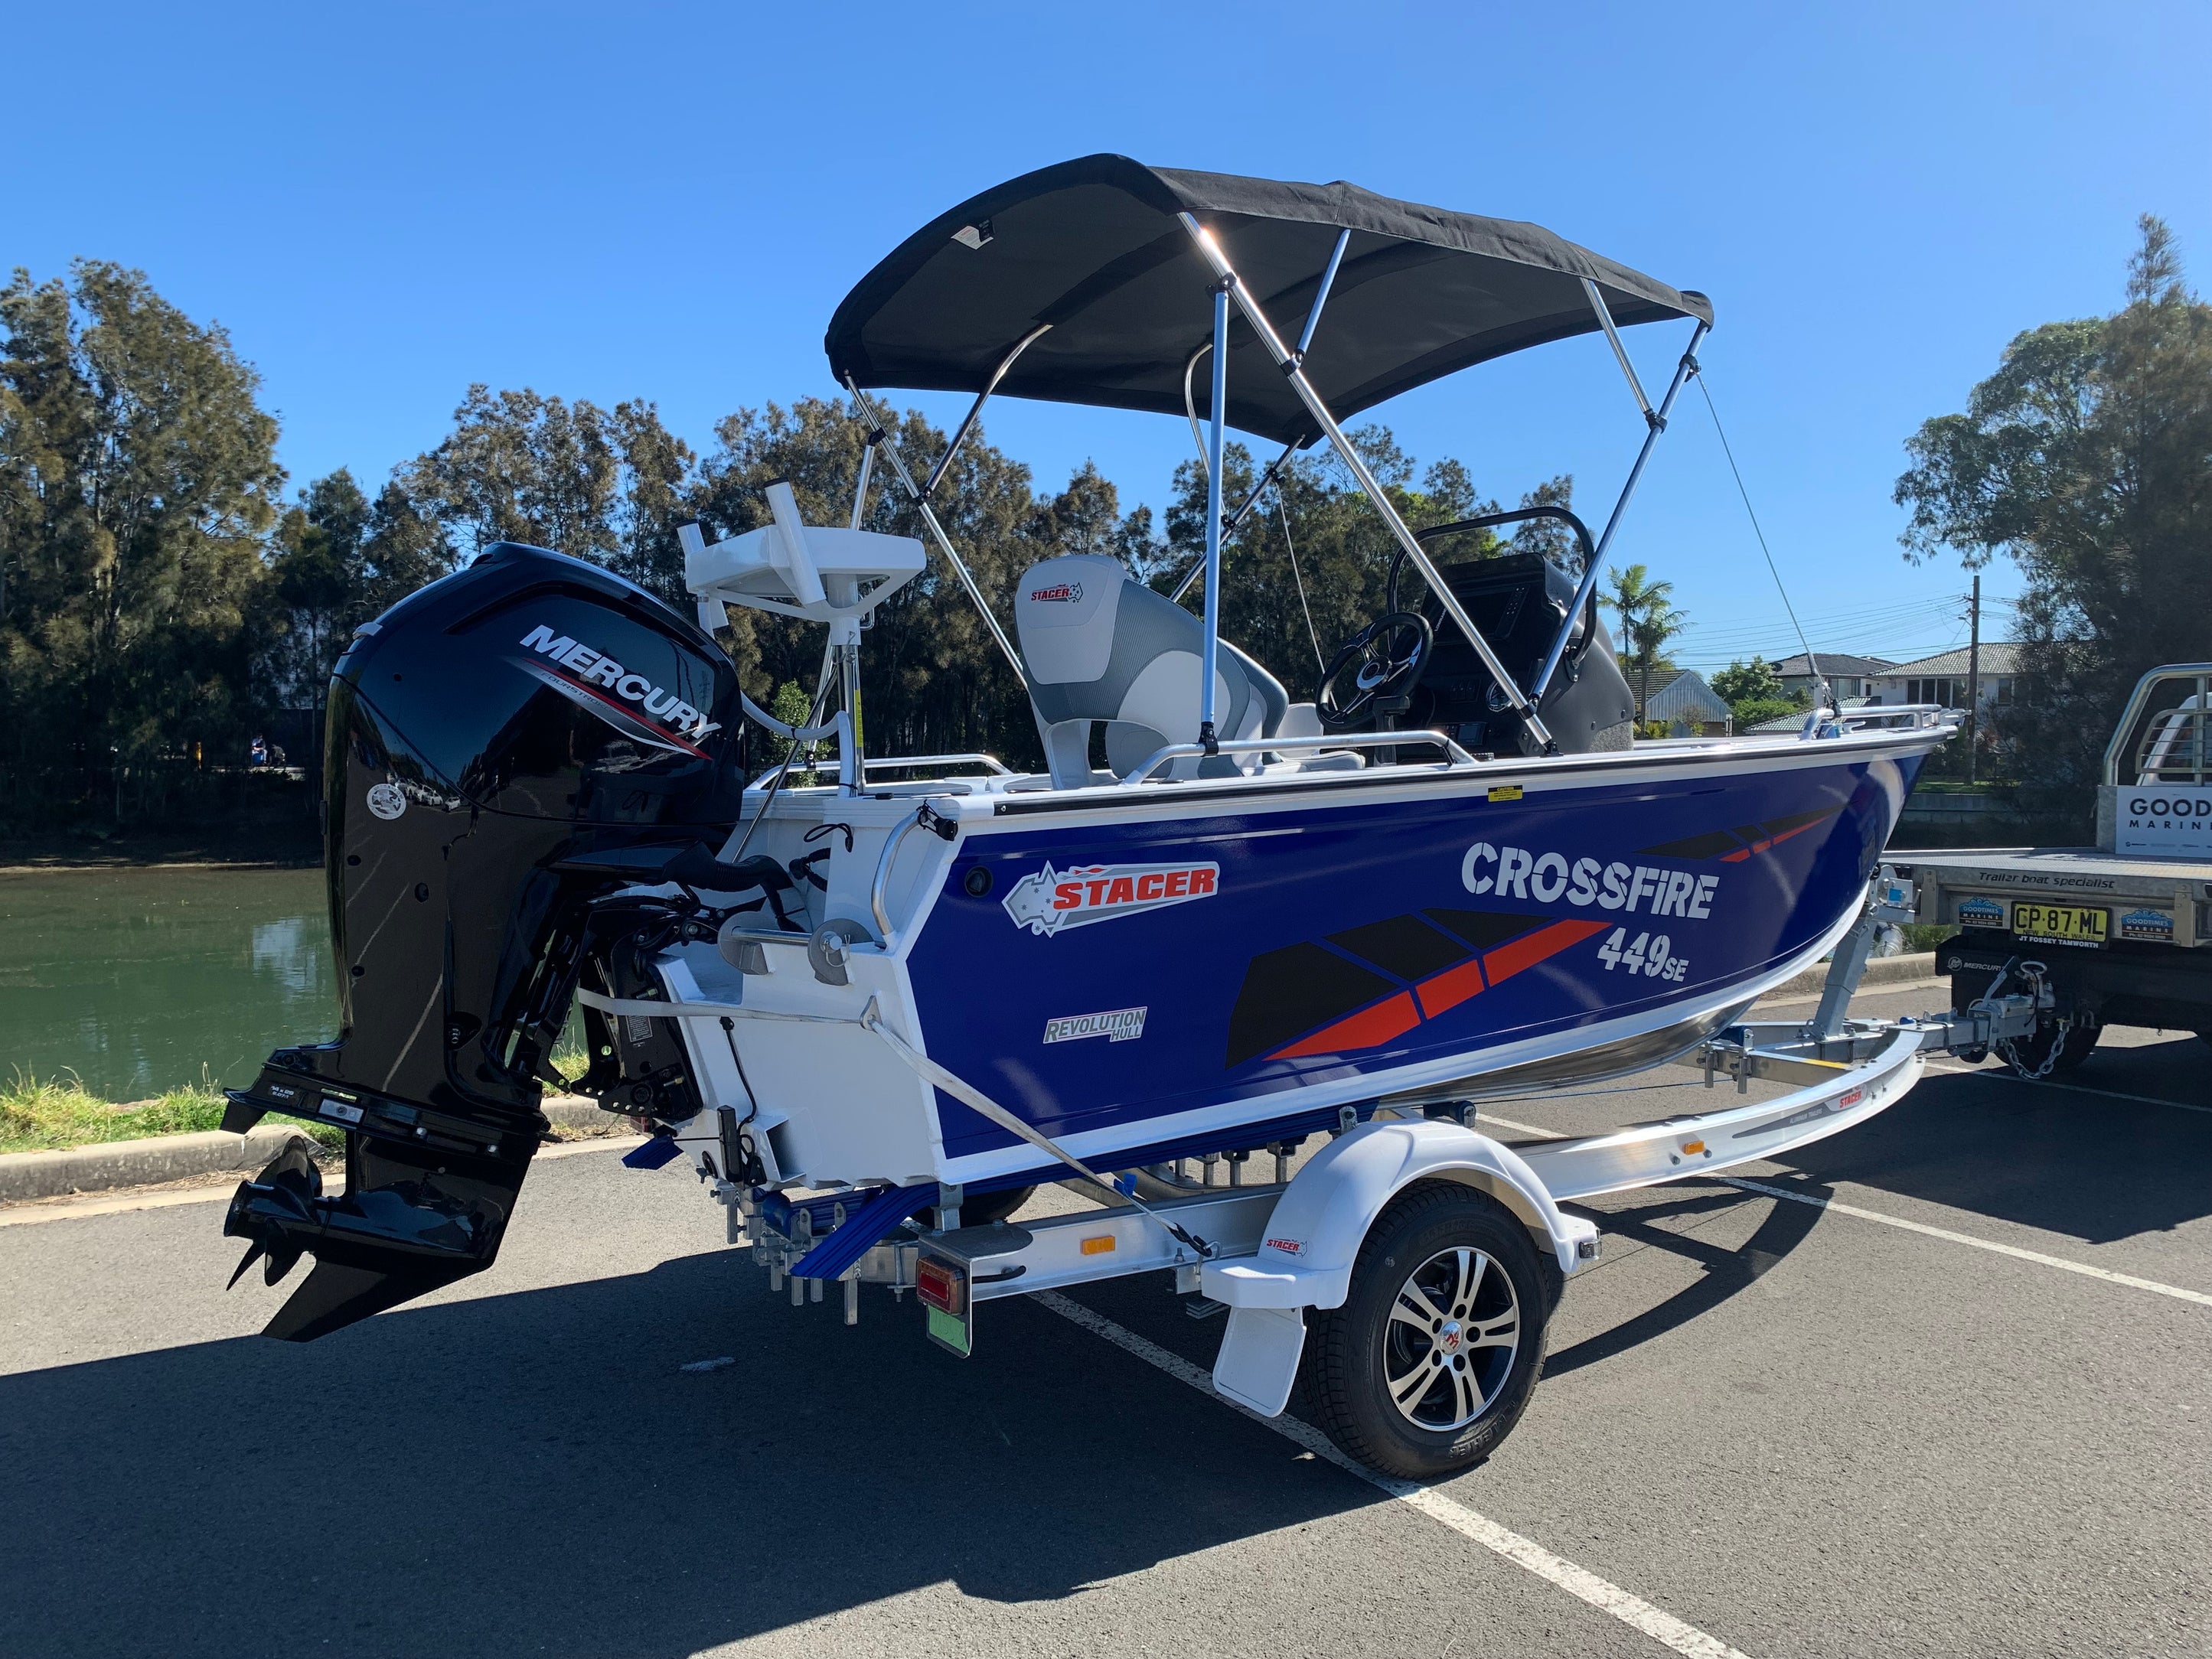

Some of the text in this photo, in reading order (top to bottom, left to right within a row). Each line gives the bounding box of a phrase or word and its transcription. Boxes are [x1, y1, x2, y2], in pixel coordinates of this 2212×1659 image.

[1031, 588, 1070, 601] STACER
[520, 624, 722, 739] MERCURY
[541, 672, 611, 711] FOURSTROKE
[2129, 798, 2212, 816] GOOD
[2129, 820, 2212, 830] MARIN
[1979, 872, 2115, 888] Trailer boat specialist
[1053, 868, 1216, 911] STACER
[2029, 936, 2057, 944] FOSSEY
[2058, 939, 2099, 948] TAMWORTH
[2044, 931, 2067, 939] SOUTH
[1045, 1010, 1145, 1042] REVOLUTION
[1111, 1025, 1140, 1041] HULL
[1838, 1090, 1862, 1108] STACER
[1267, 1239, 1300, 1251] STACER
